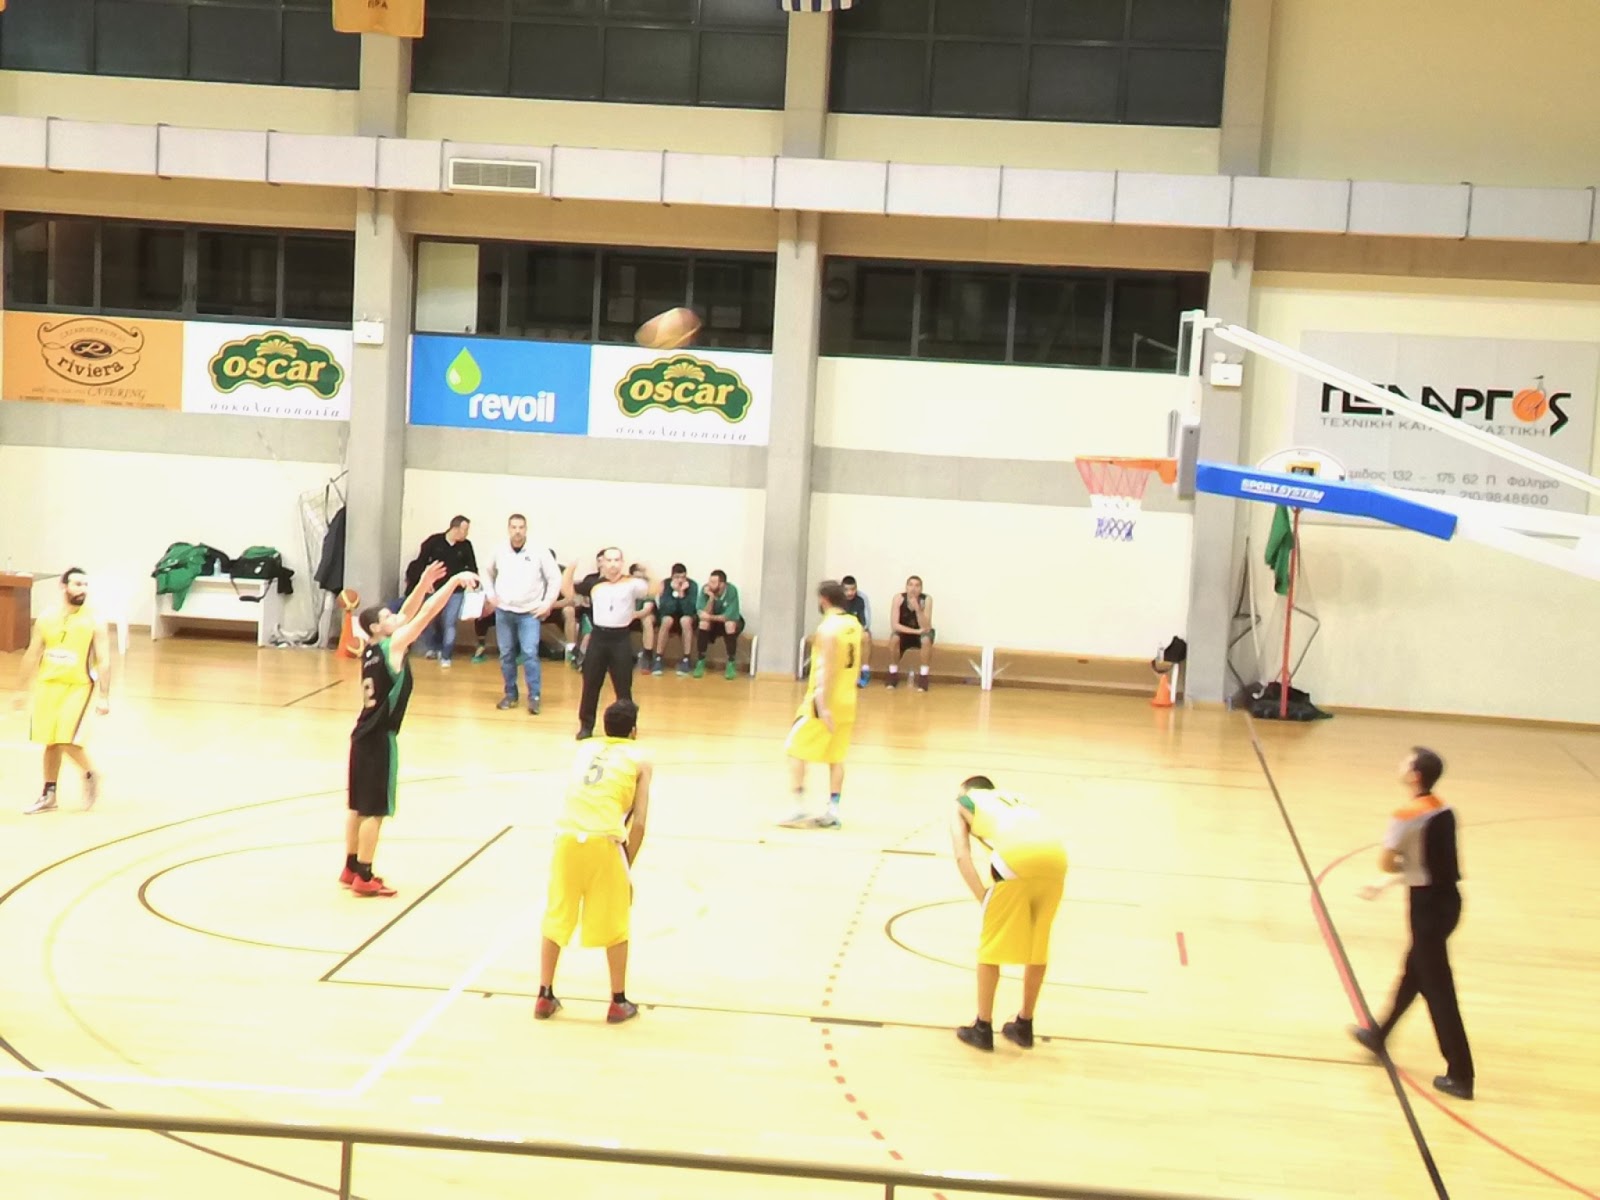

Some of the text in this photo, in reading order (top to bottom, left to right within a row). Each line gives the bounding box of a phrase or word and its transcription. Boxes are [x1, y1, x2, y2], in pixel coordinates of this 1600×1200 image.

[57, 356, 124, 378] riviera
[223, 355, 327, 382] oscar
[629, 378, 735, 405] oscar
[468, 390, 555, 423] revoil
[1393, 470, 1413, 481] 132
[1462, 474, 1479, 485] 62
